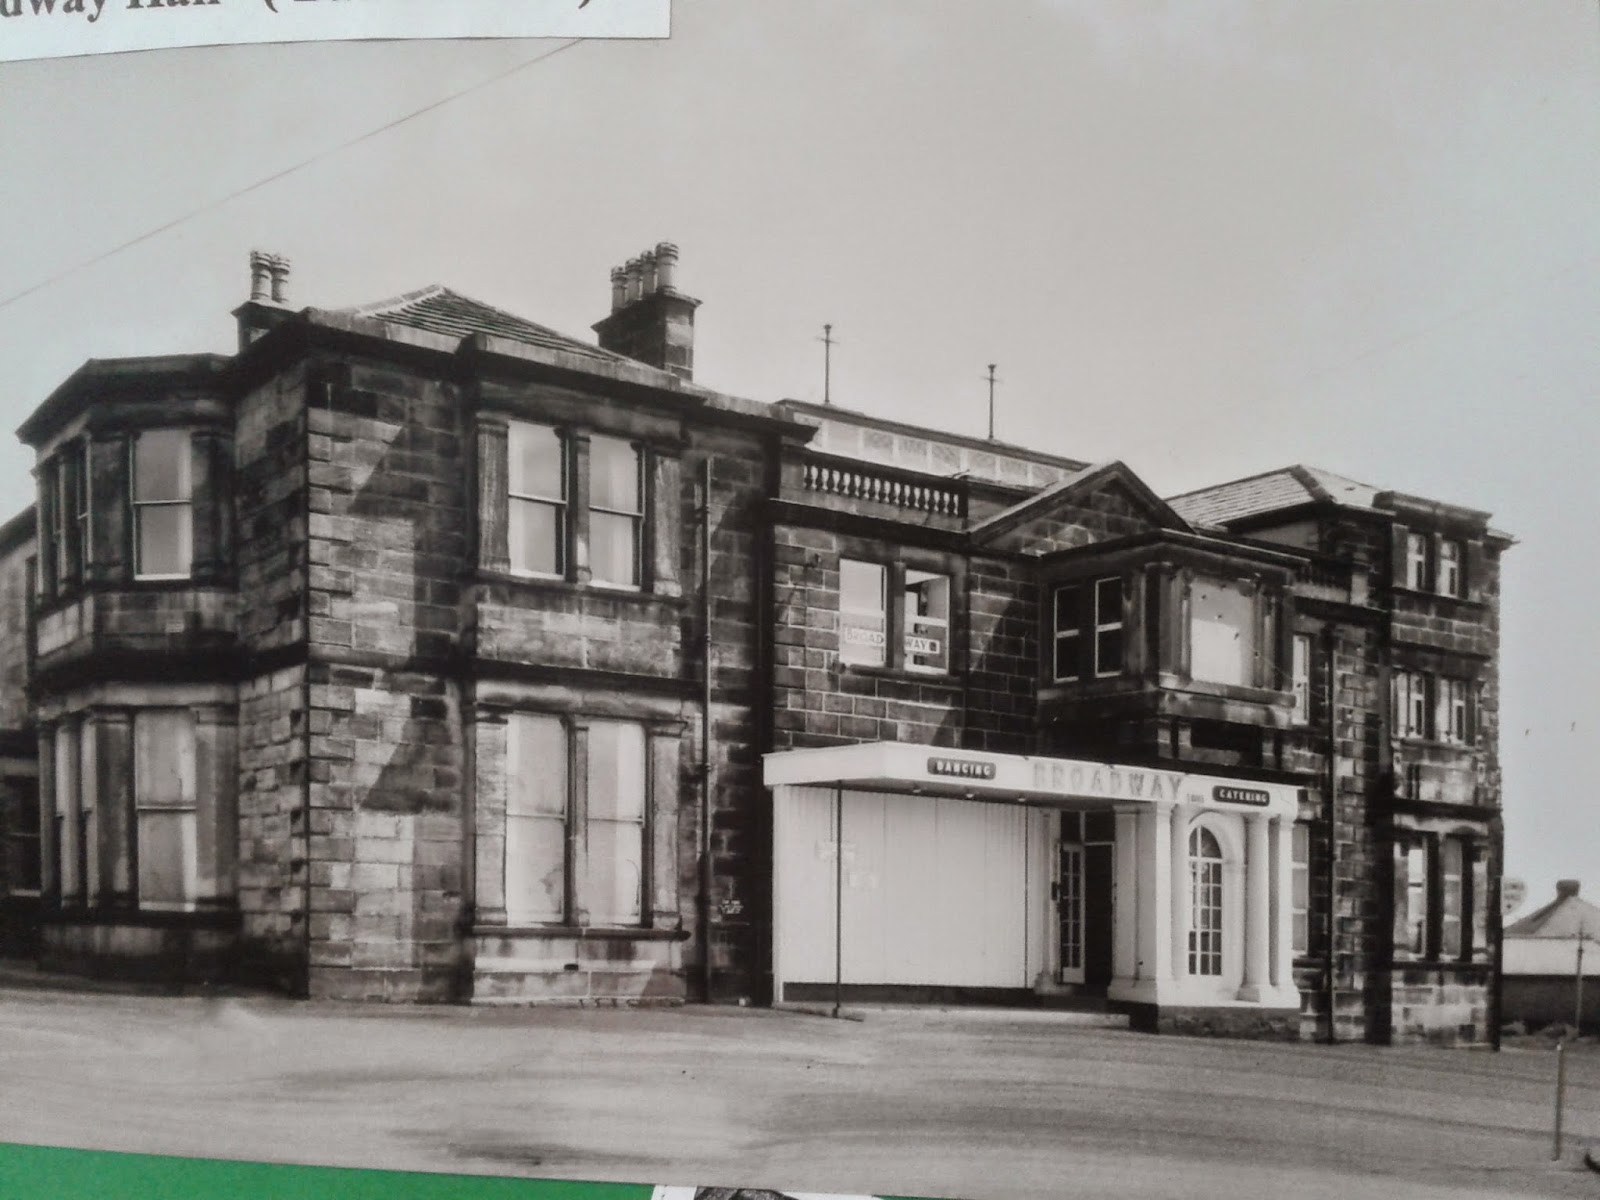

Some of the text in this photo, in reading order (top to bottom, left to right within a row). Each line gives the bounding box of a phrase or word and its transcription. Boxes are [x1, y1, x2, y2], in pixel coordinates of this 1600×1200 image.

[936, 760, 991, 776] DANCING
[1033, 760, 1183, 800] BROADWAY
[1219, 788, 1268, 803] CATERING
